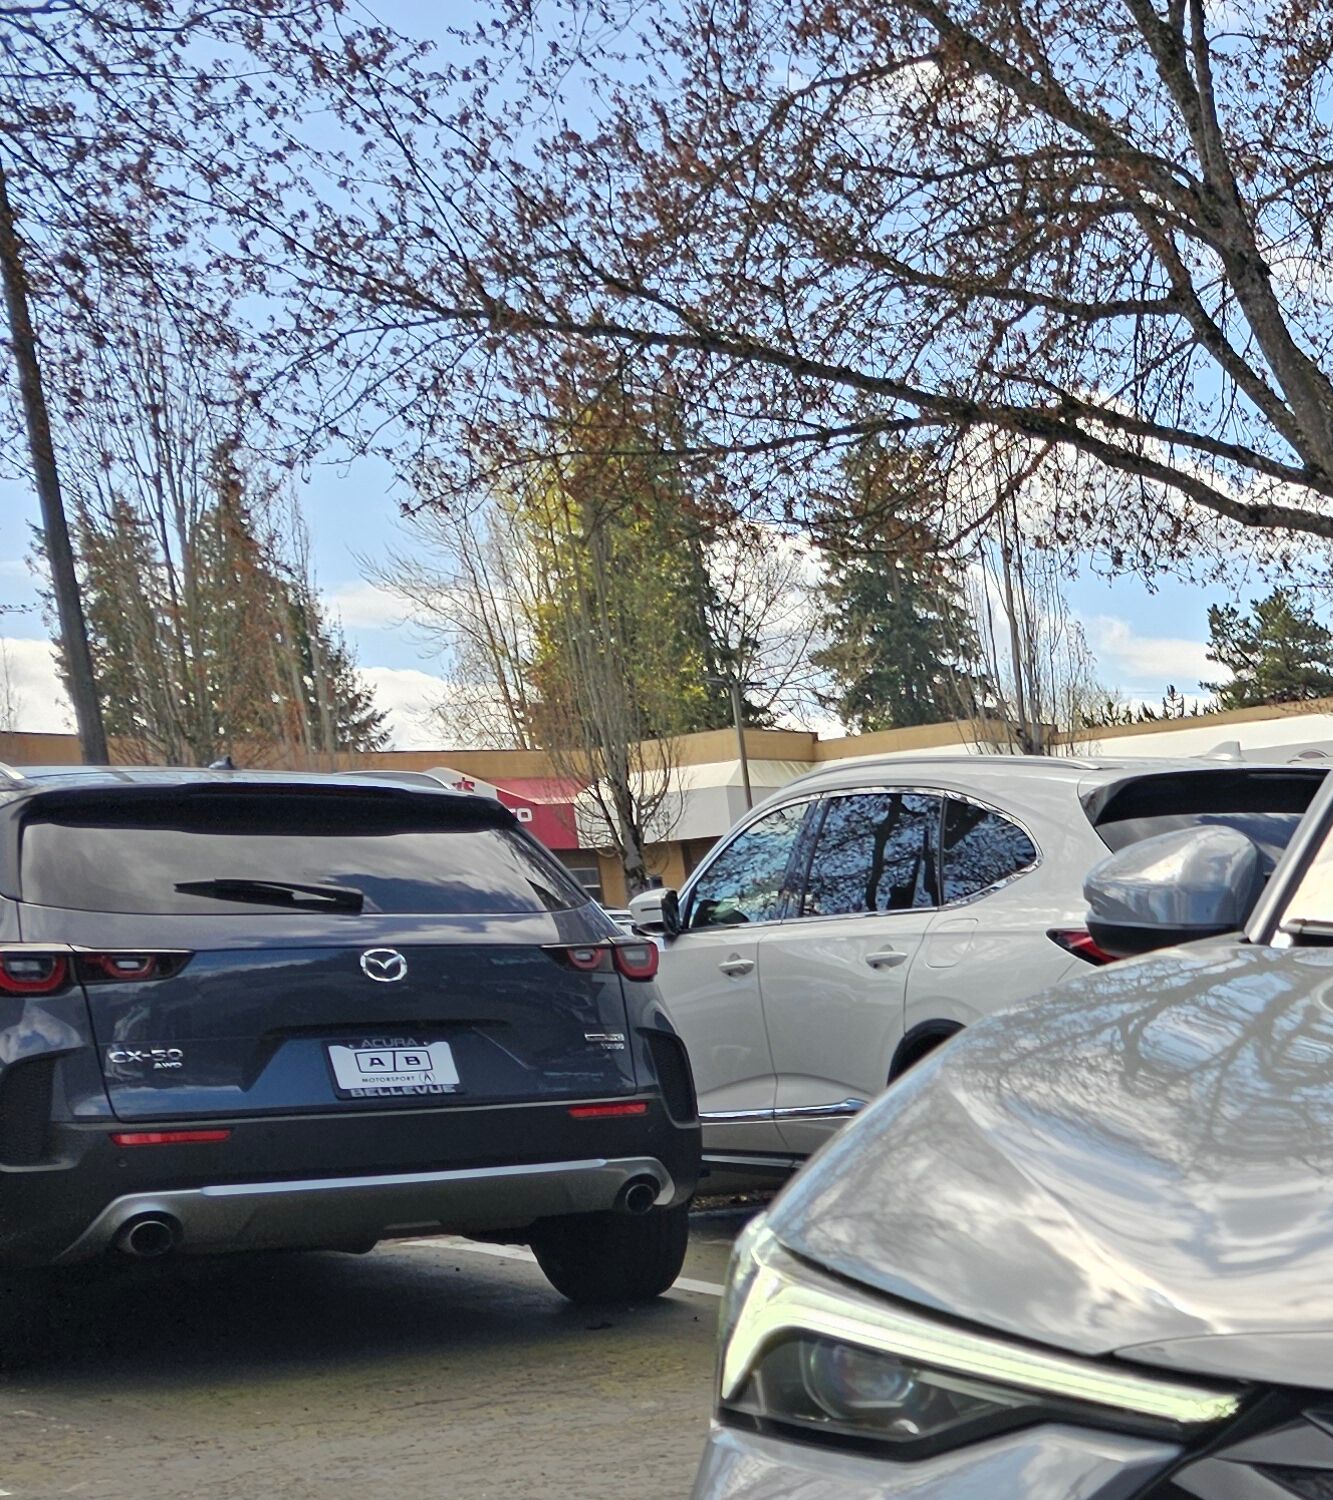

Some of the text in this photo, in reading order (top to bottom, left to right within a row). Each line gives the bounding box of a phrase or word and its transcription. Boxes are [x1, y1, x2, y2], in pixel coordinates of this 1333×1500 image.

[361, 1037, 419, 1048] ACURA
[108, 1048, 184, 1063] CX-50
[361, 1075, 415, 1083] MOTORSPORT
[350, 1084, 457, 1097] BELLEVUE
